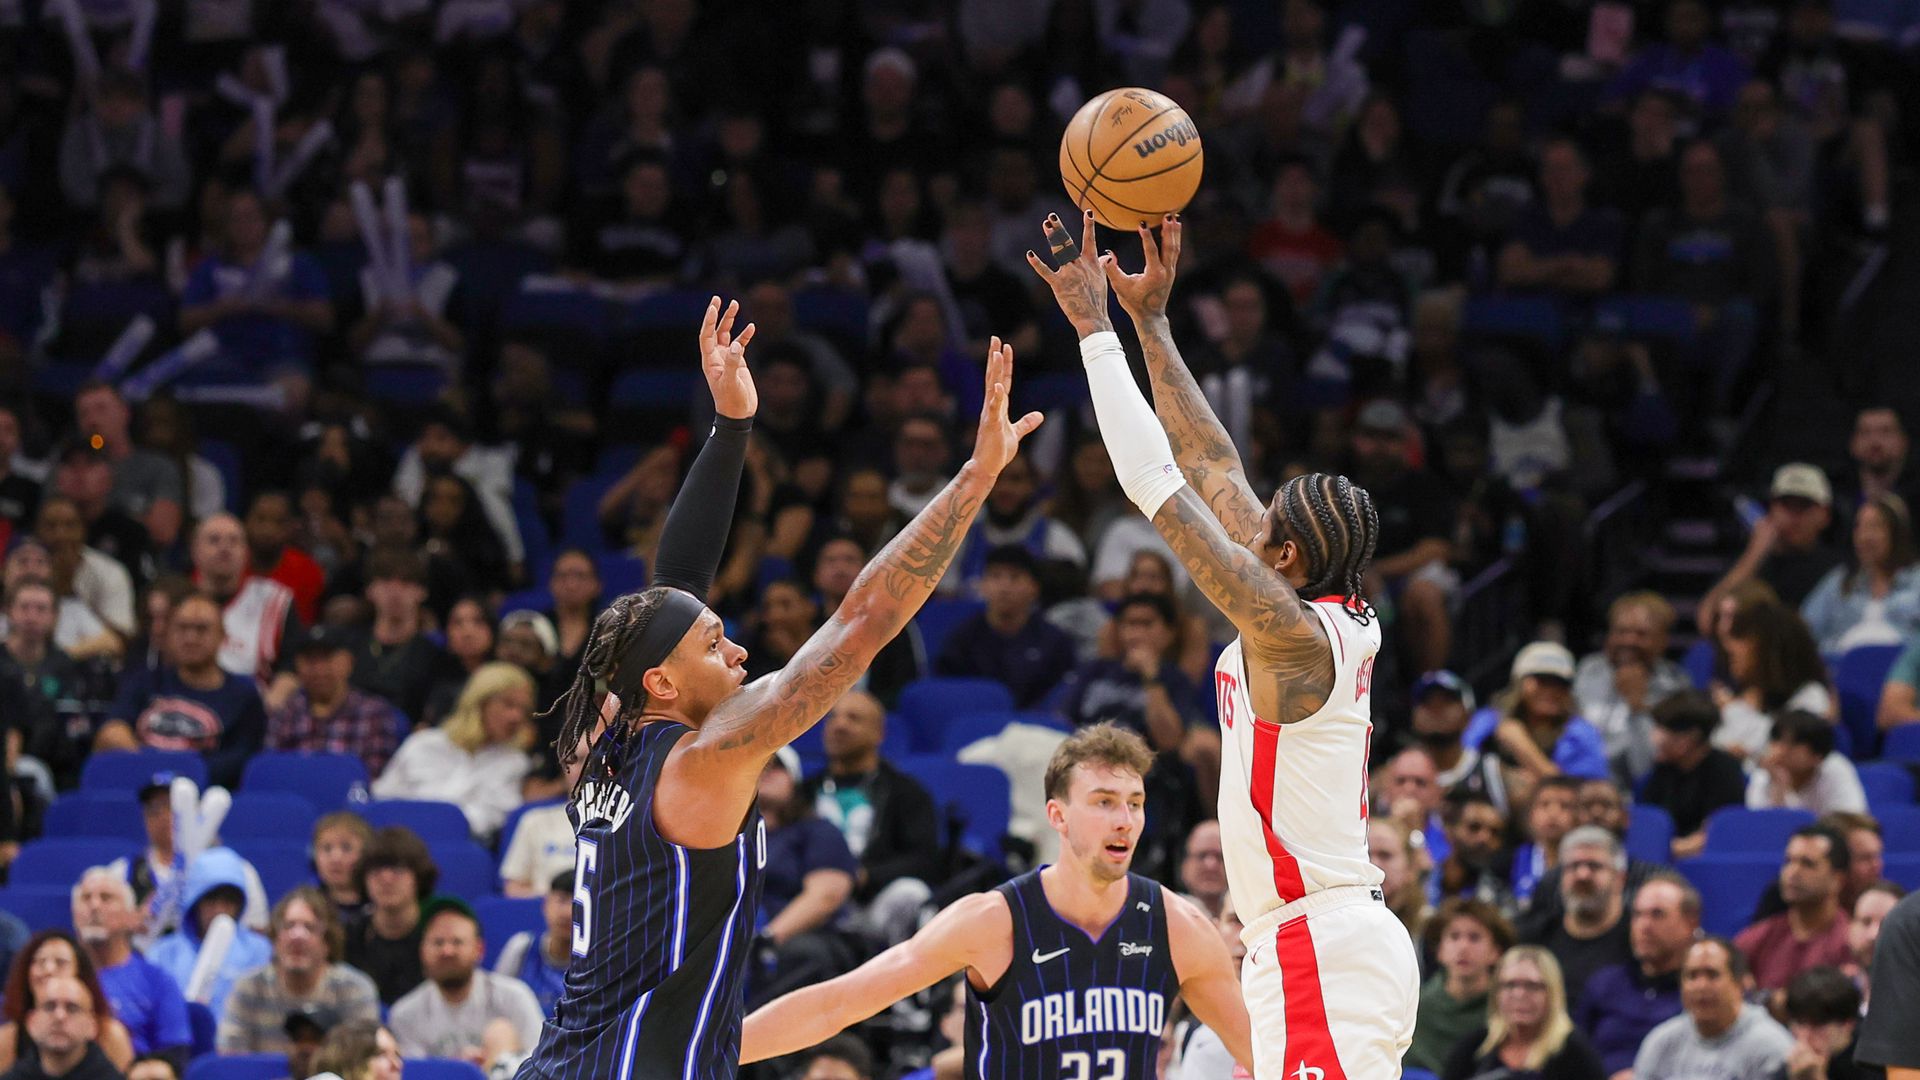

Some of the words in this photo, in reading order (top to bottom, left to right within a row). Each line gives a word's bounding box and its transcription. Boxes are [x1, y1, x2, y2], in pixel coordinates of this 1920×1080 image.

[572, 836, 598, 958] 5
[1118, 942, 1153, 957] Disney
[1021, 986, 1164, 1045] ORLANDO
